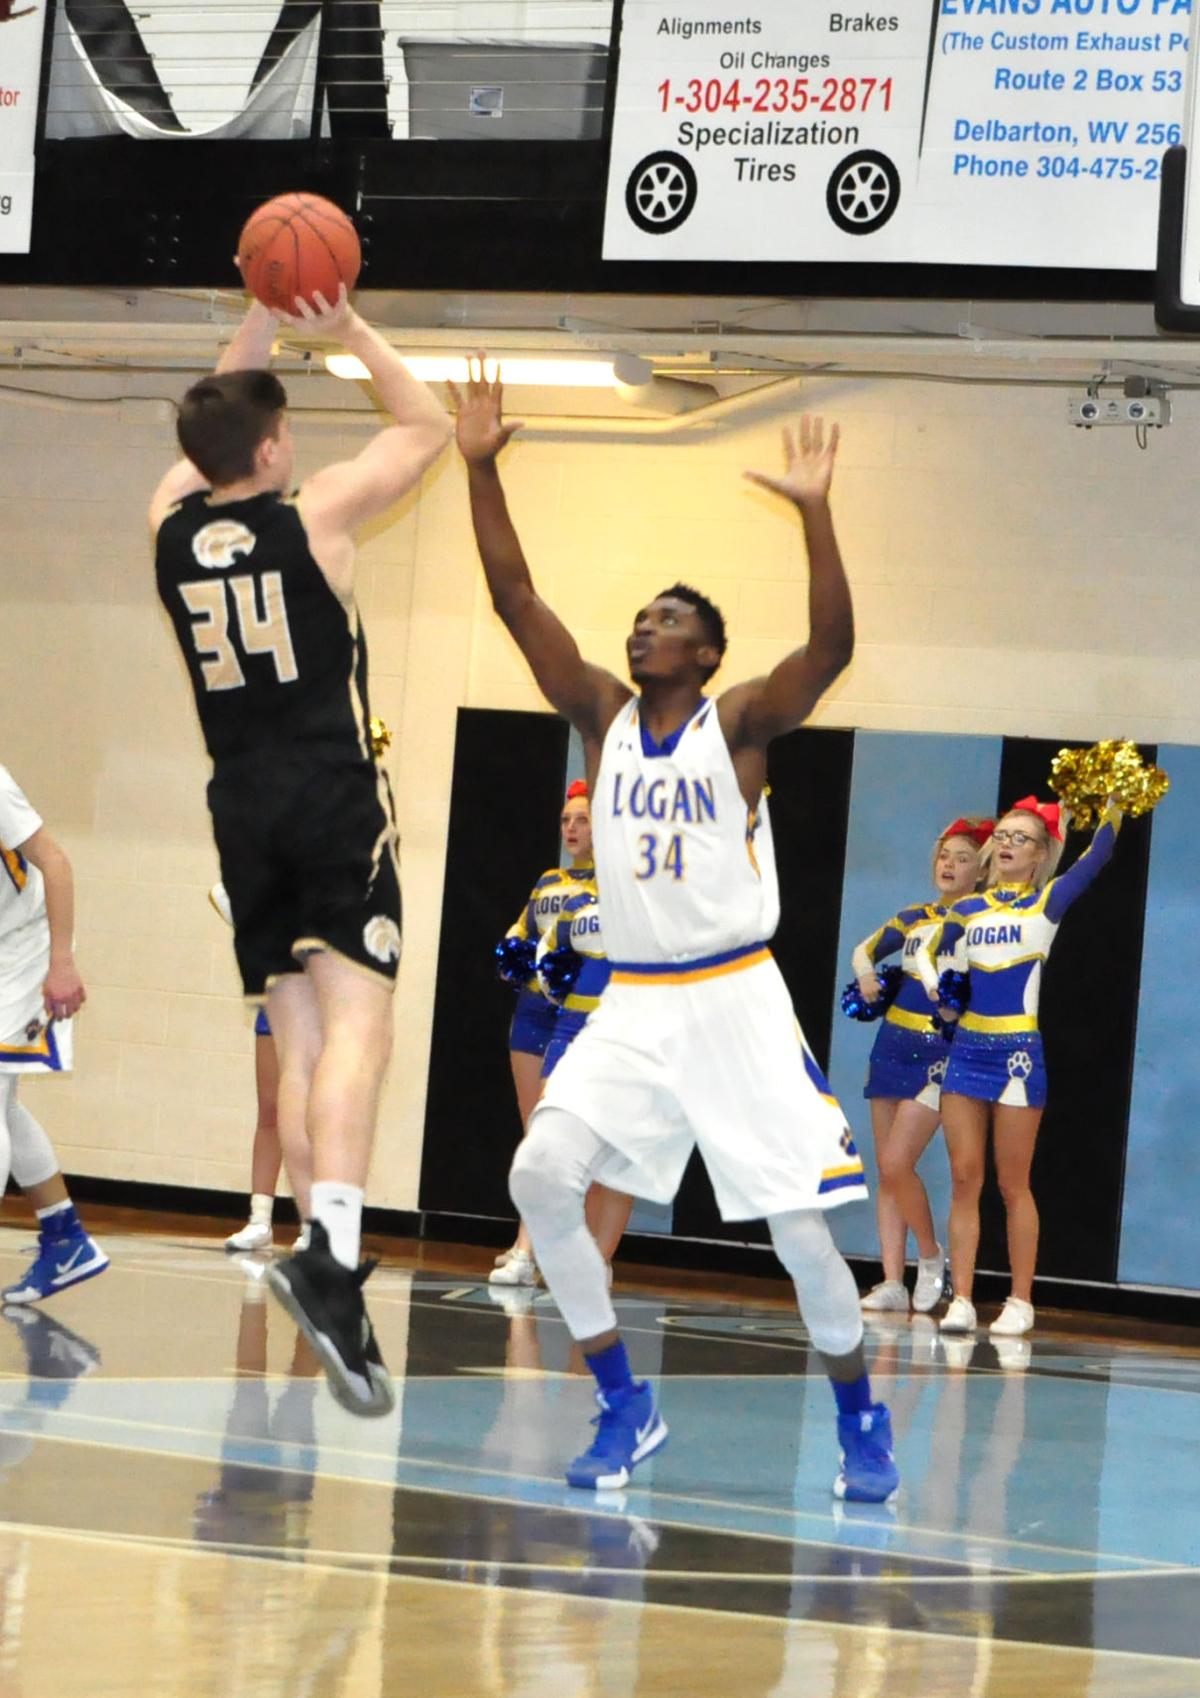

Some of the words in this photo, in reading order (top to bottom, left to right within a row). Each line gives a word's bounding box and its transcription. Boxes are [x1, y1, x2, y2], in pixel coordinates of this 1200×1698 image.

[657, 17, 762, 39] Alignments
[829, 12, 899, 33] Brakes
[941, 31, 984, 56] (The
[990, 32, 1069, 51] Custom
[1076, 31, 1161, 52] Exhaust
[720, 51, 744, 69] Oil
[751, 51, 830, 72] Changes
[994, 68, 1065, 91] Route
[1073, 69, 1088, 91] 2
[1096, 69, 1143, 92] Box
[1151, 70, 1182, 92] 53
[657, 77, 893, 113] 1-304-235-2871
[677, 120, 860, 152] Specialization
[953, 119, 1079, 148] Delbarton,
[1088, 121, 1129, 144] WV
[734, 157, 797, 182] Tires
[953, 154, 1029, 177] Phone
[1036, 156, 1161, 181] 304-475-2
[178, 570, 299, 692] 34
[612, 772, 717, 824] LOGAN
[634, 831, 688, 882] 34
[966, 924, 1022, 946] LOGAN
